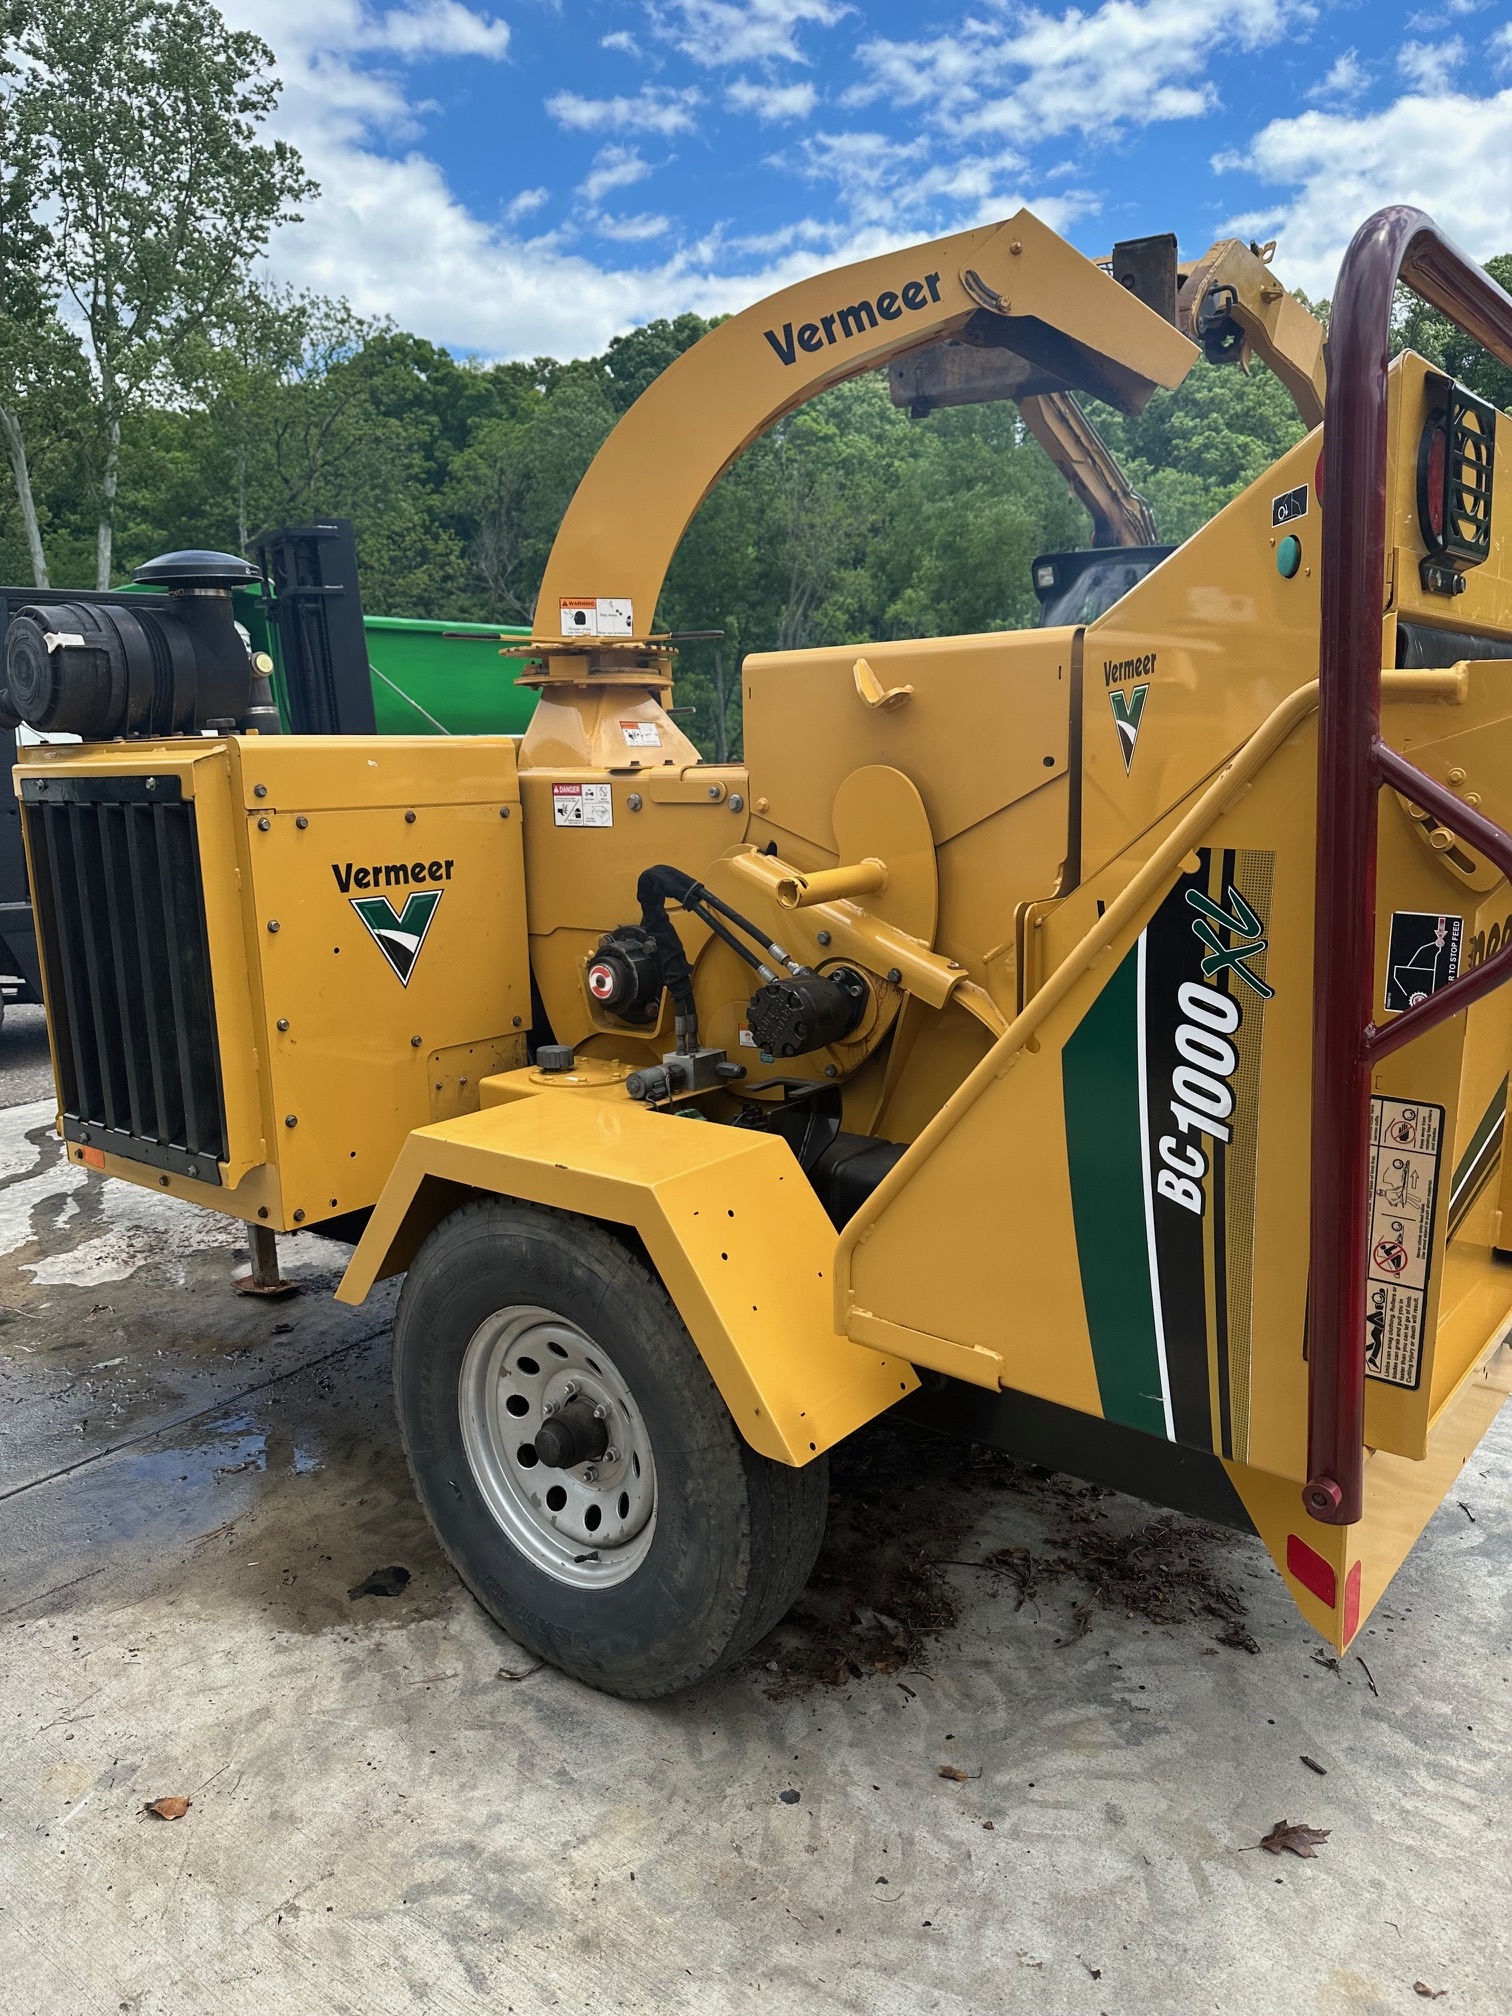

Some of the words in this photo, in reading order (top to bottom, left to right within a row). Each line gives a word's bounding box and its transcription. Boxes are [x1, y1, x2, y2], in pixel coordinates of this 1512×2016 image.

[763, 271, 941, 366] Vermeer
[1104, 652, 1156, 687] Vermeer
[560, 786, 580, 794] DANGER
[331, 859, 454, 893] Vermeer
[1185, 885, 1273, 999] XL
[1452, 921, 1460, 941] FEED
[1448, 964, 1456, 974] TO
[1450, 942, 1458, 962] STOP
[513, 1258, 580, 1299] S637
[1406, 1364, 1414, 1383] Cutting
[484, 1574, 572, 1645] SAILUN
